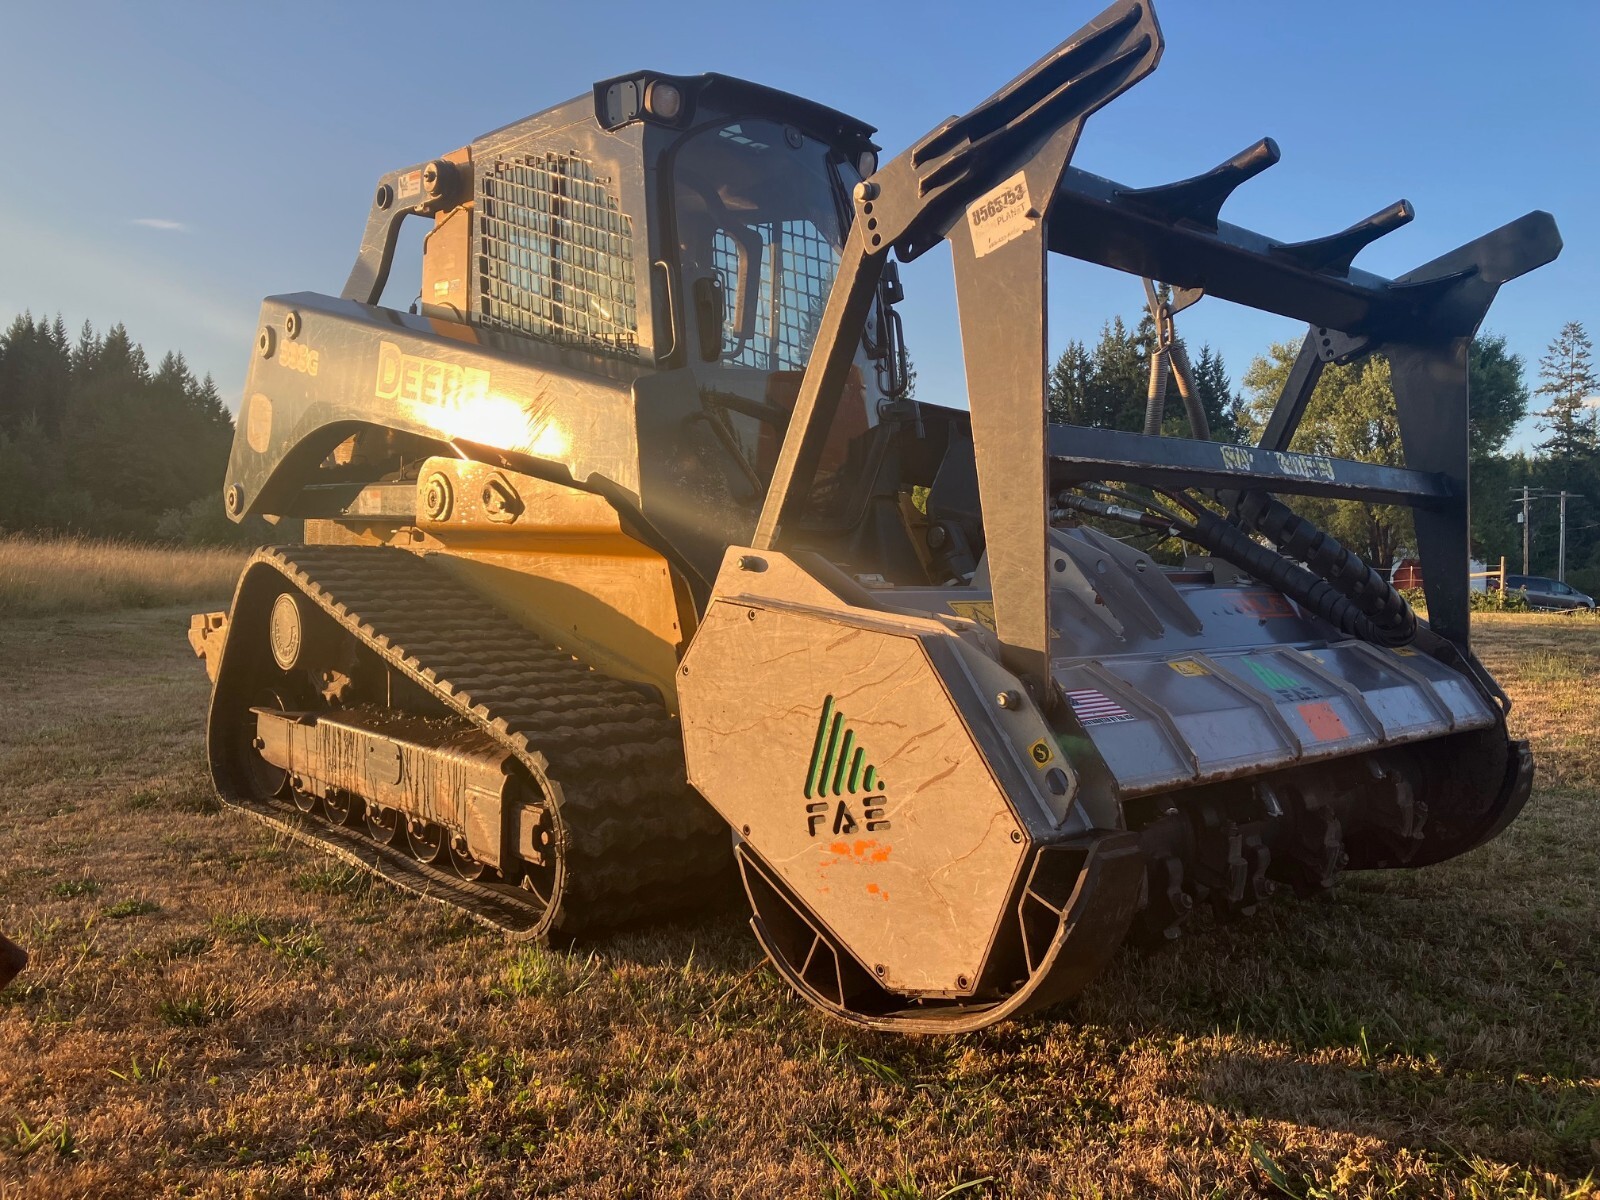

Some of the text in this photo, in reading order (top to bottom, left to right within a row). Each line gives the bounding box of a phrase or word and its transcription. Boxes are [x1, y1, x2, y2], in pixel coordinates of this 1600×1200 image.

[972, 183, 1026, 226] U565753
[375, 340, 490, 412] DEER
[806, 796, 892, 837] FAE
